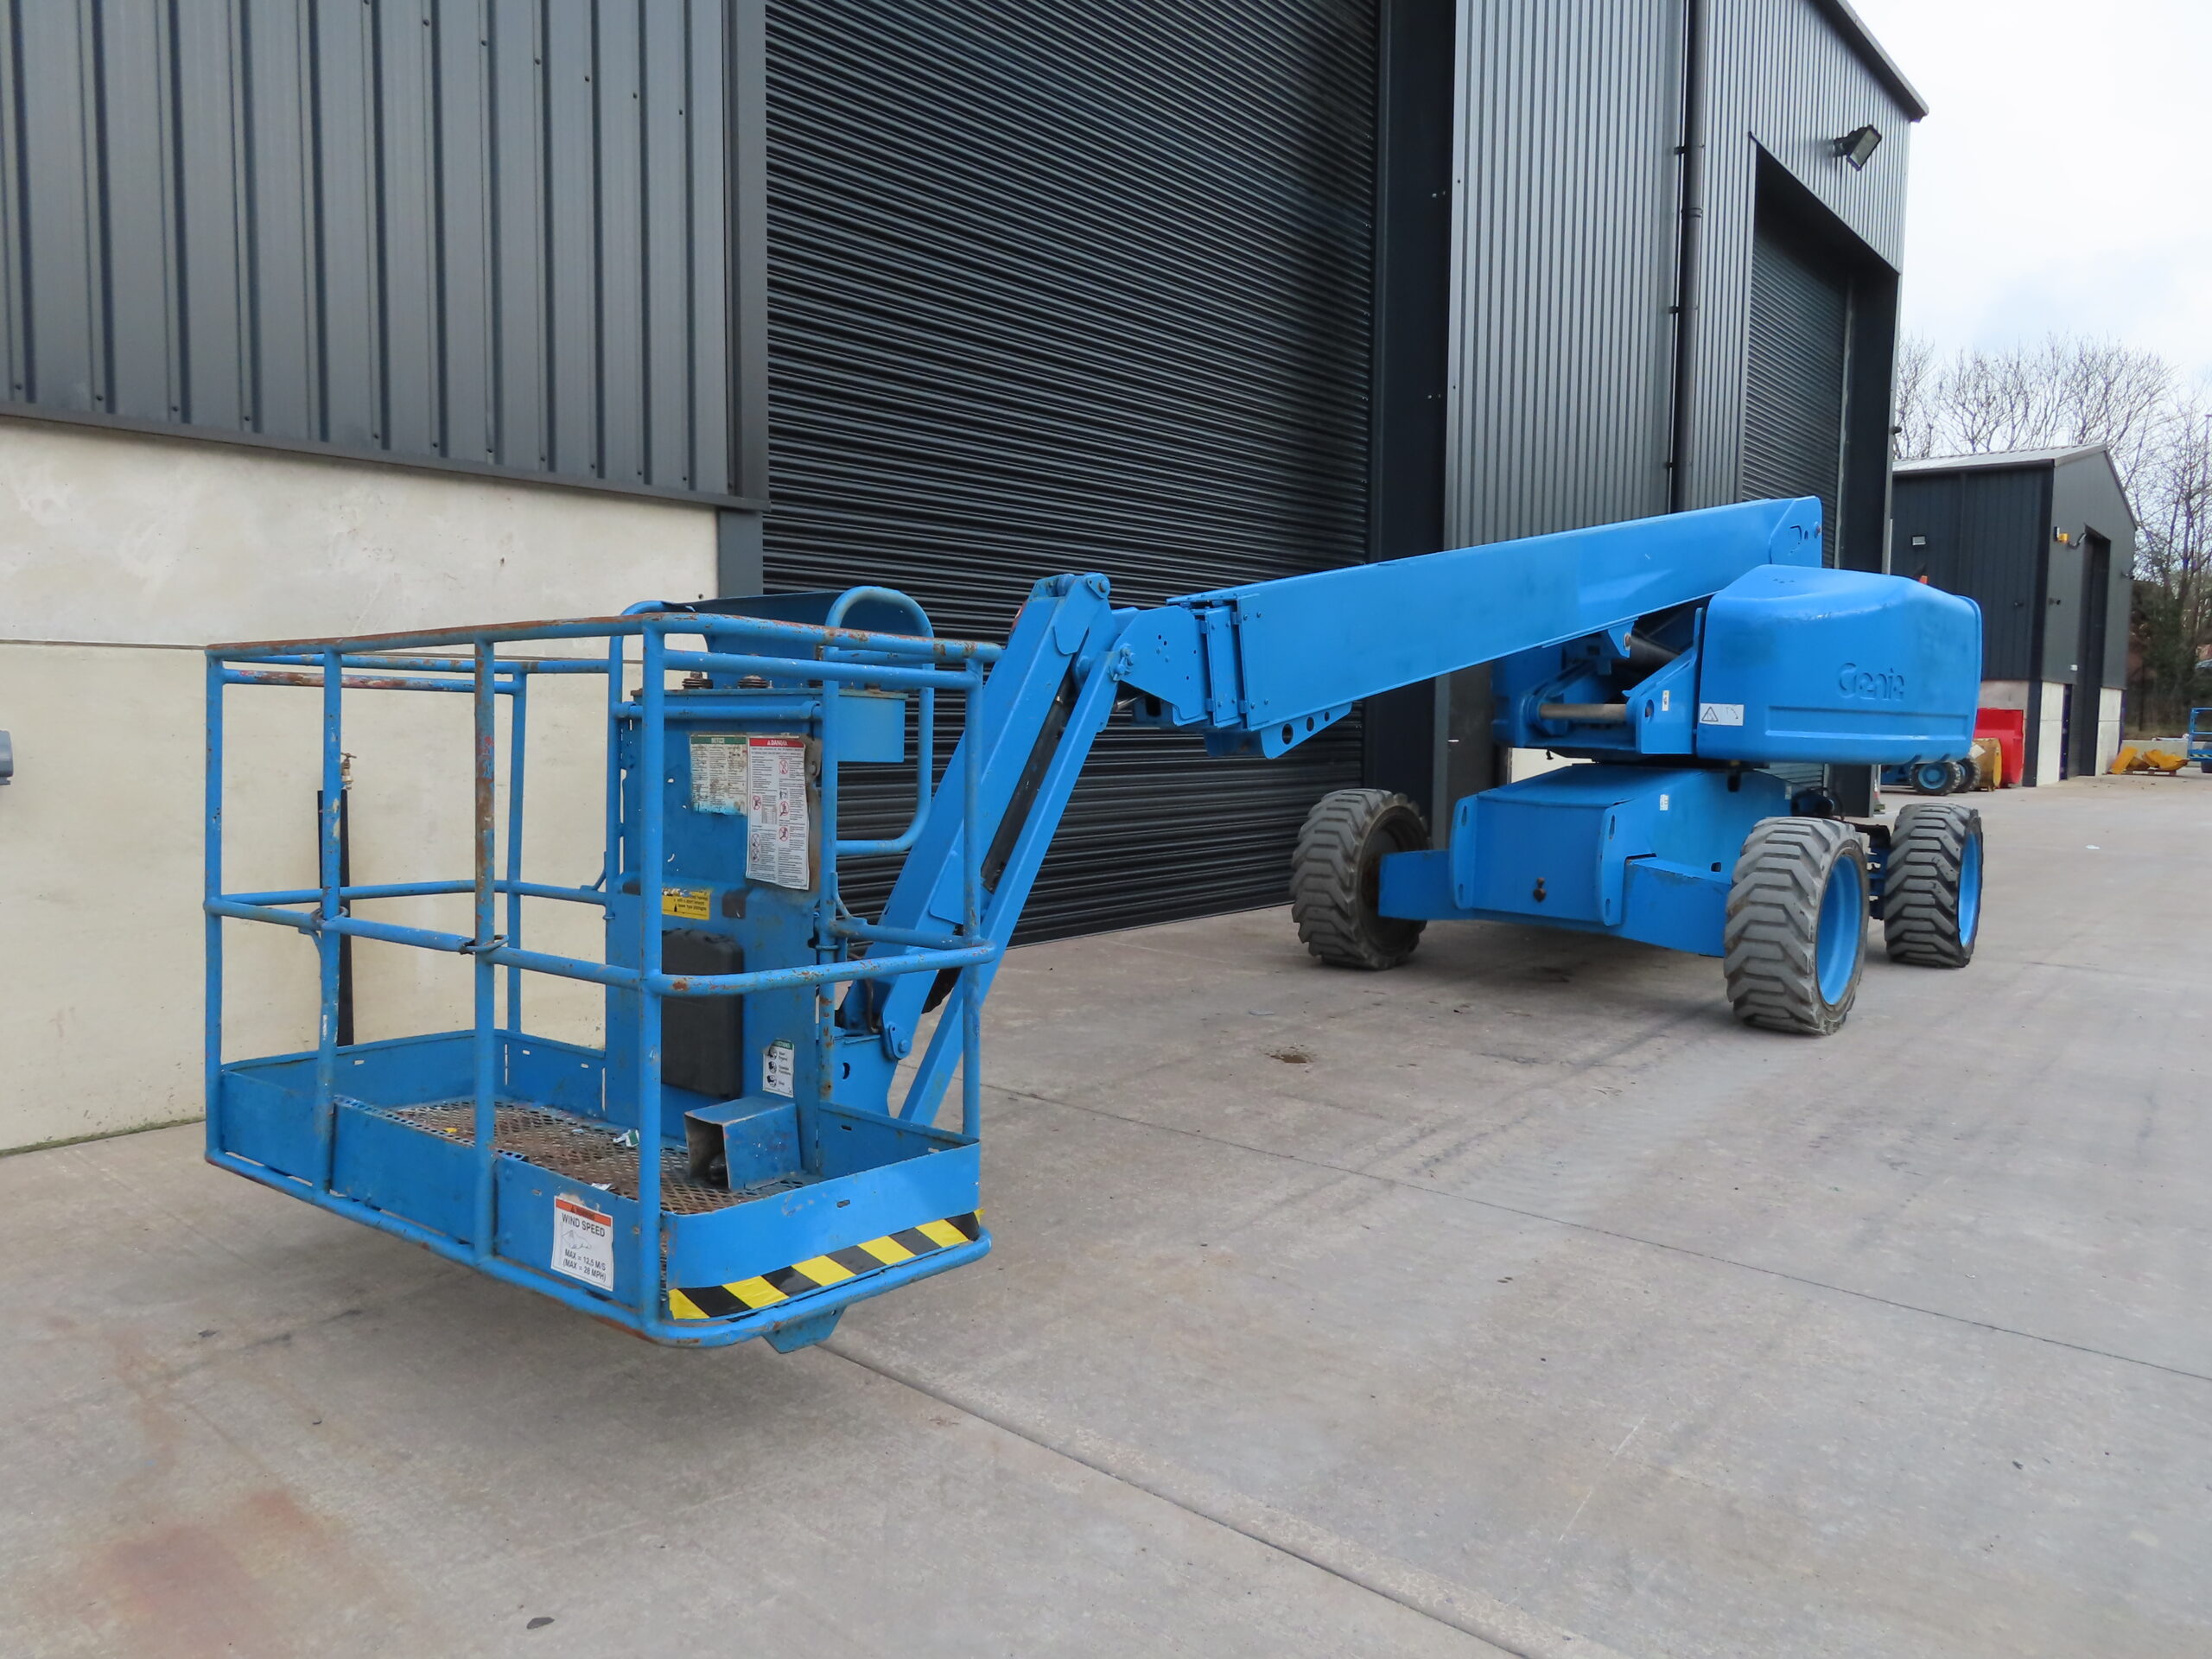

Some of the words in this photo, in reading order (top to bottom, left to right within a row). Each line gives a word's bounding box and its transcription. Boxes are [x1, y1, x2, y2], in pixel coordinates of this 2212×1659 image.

[1838, 662, 1905, 702] Genie
[562, 1212, 580, 1228] WIND
[582, 1220, 605, 1237] SPEED
[565, 1248, 576, 1259] MAX
[563, 1258, 577, 1269] (MAX
[591, 1268, 607, 1282] MPH)
